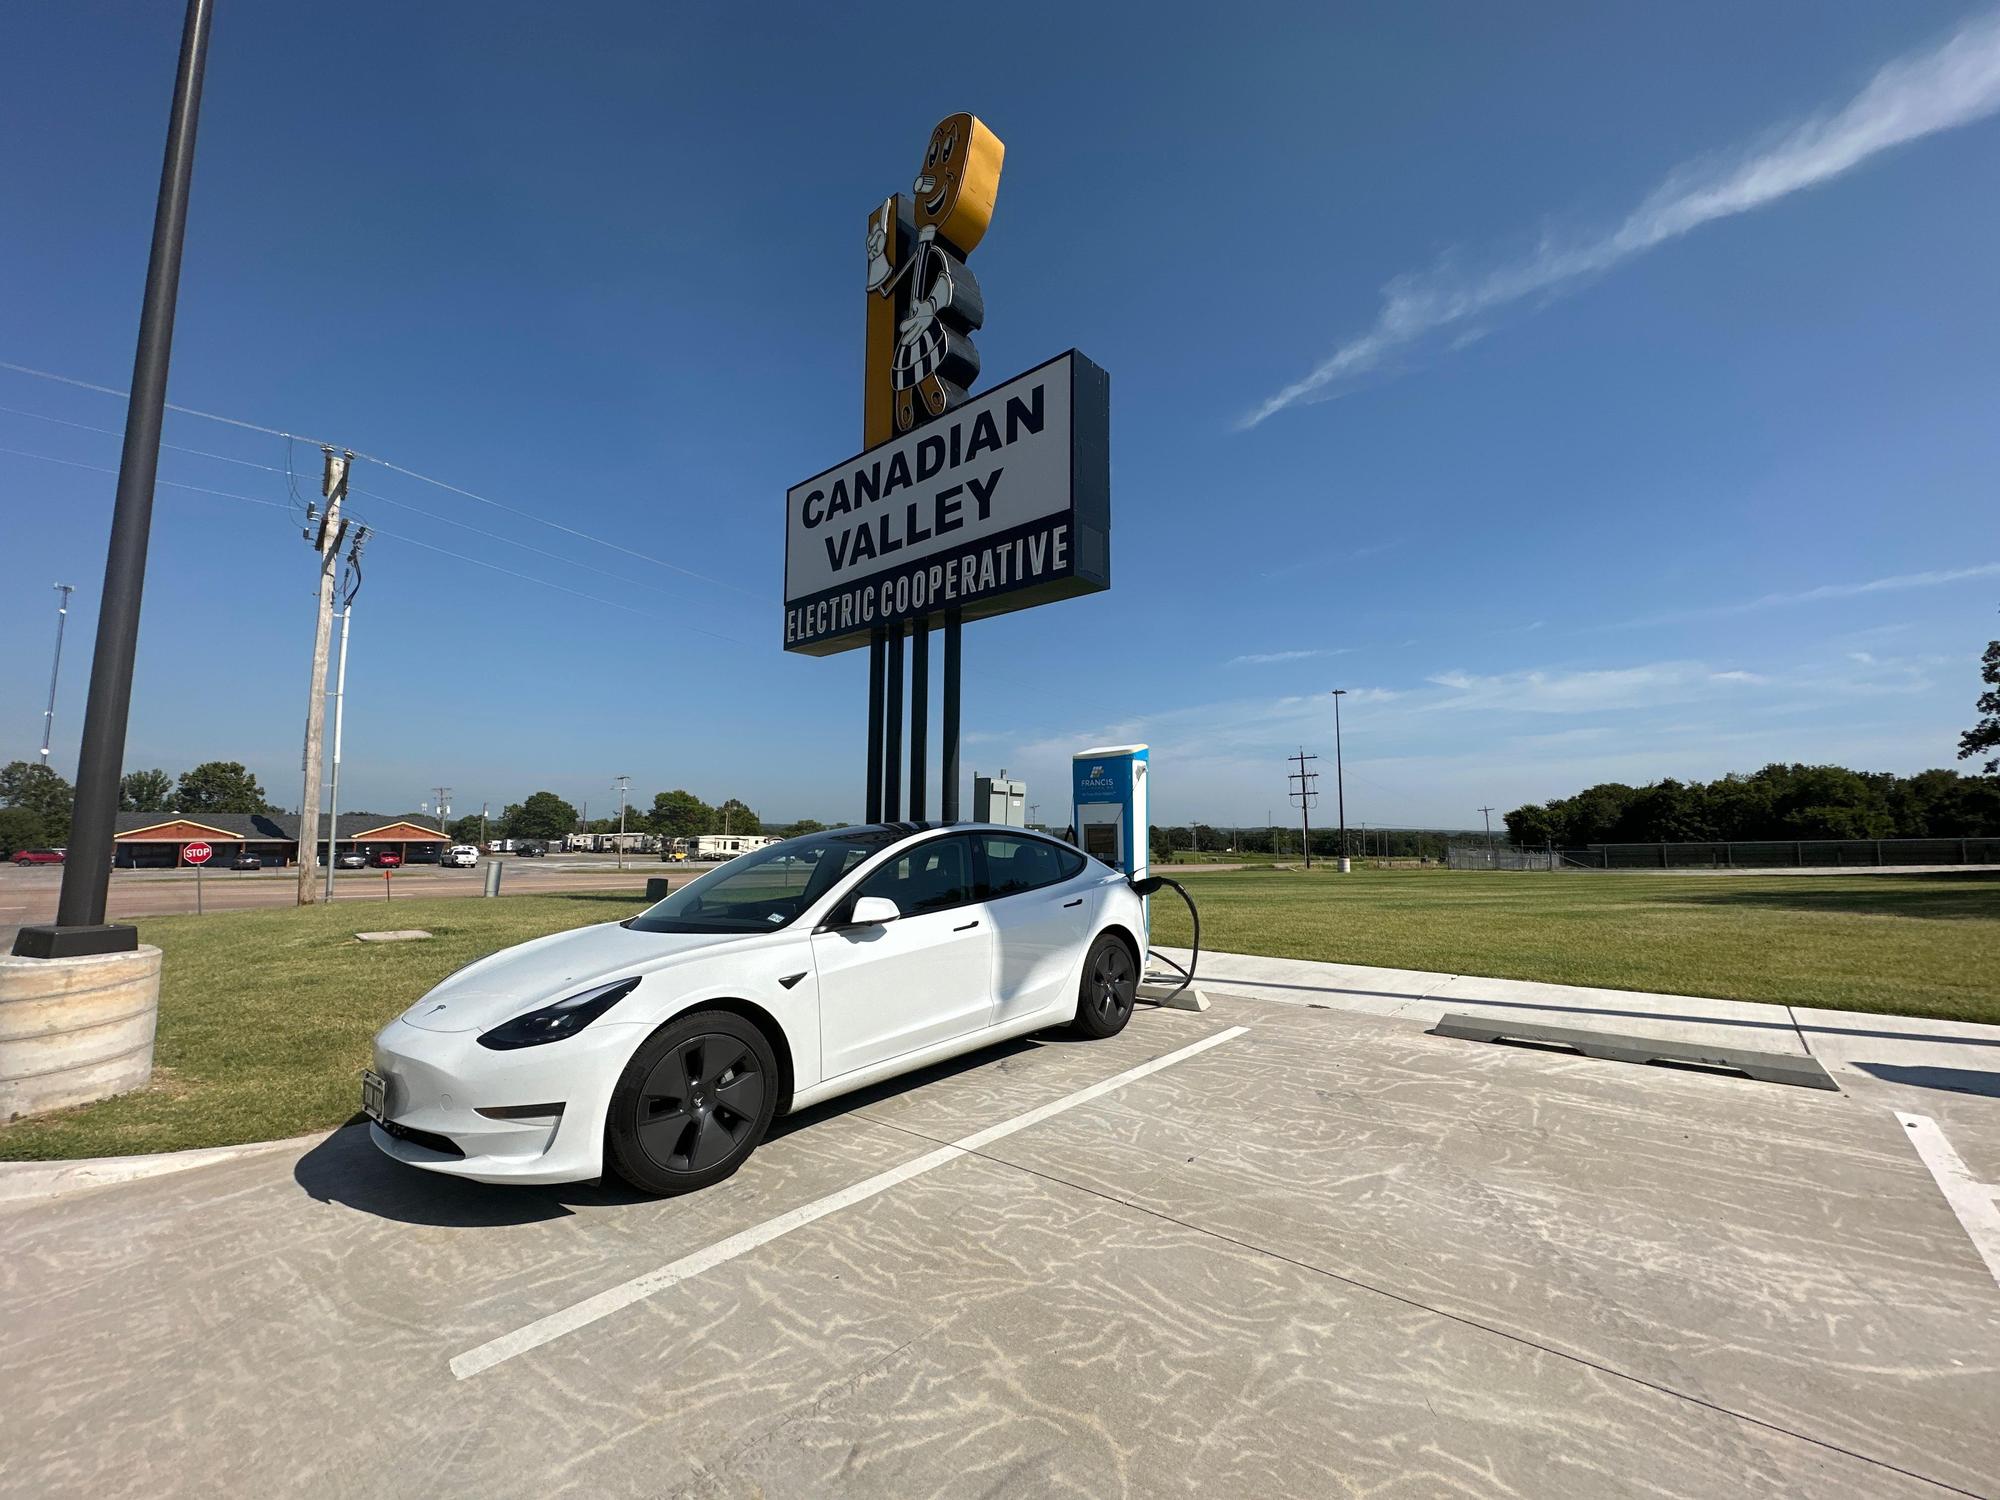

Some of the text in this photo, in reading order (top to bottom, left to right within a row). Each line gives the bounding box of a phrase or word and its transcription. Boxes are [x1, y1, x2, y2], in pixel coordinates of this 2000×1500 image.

[801, 384, 1045, 529] CANADIAN
[824, 467, 1005, 573] VALLEY
[786, 524, 1068, 643] ELECTRIC COOPERATIVE
[1081, 778, 1114, 787] FRANCIS
[186, 848, 210, 858] STOP
